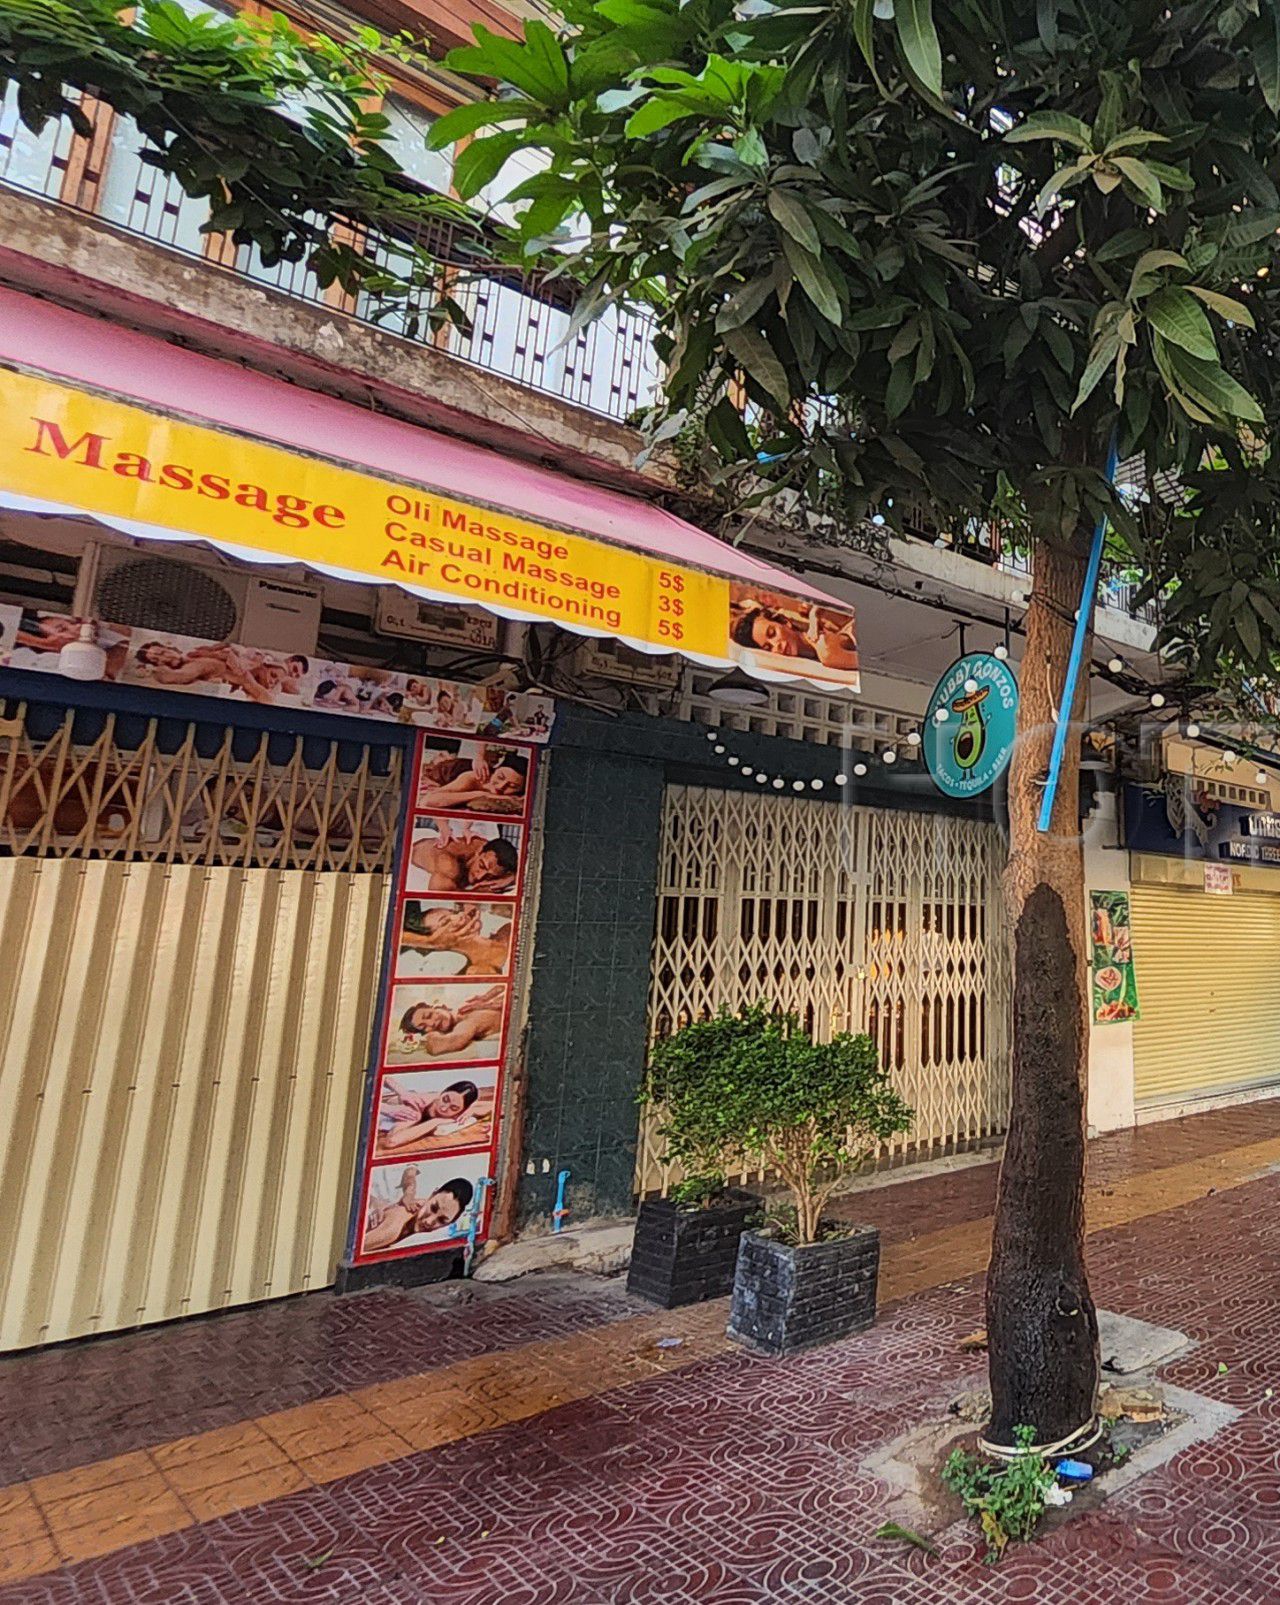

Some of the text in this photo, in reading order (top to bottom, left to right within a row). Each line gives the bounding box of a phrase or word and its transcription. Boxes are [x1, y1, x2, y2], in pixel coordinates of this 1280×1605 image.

[23, 416, 346, 529] Massage
[385, 522, 685, 616] Casual Massage 3$
[386, 494, 685, 593] Oli Massage 5$
[381, 550, 684, 640] Air Conditioning 5$
[932, 660, 1014, 729] CUBBY GONZOS
